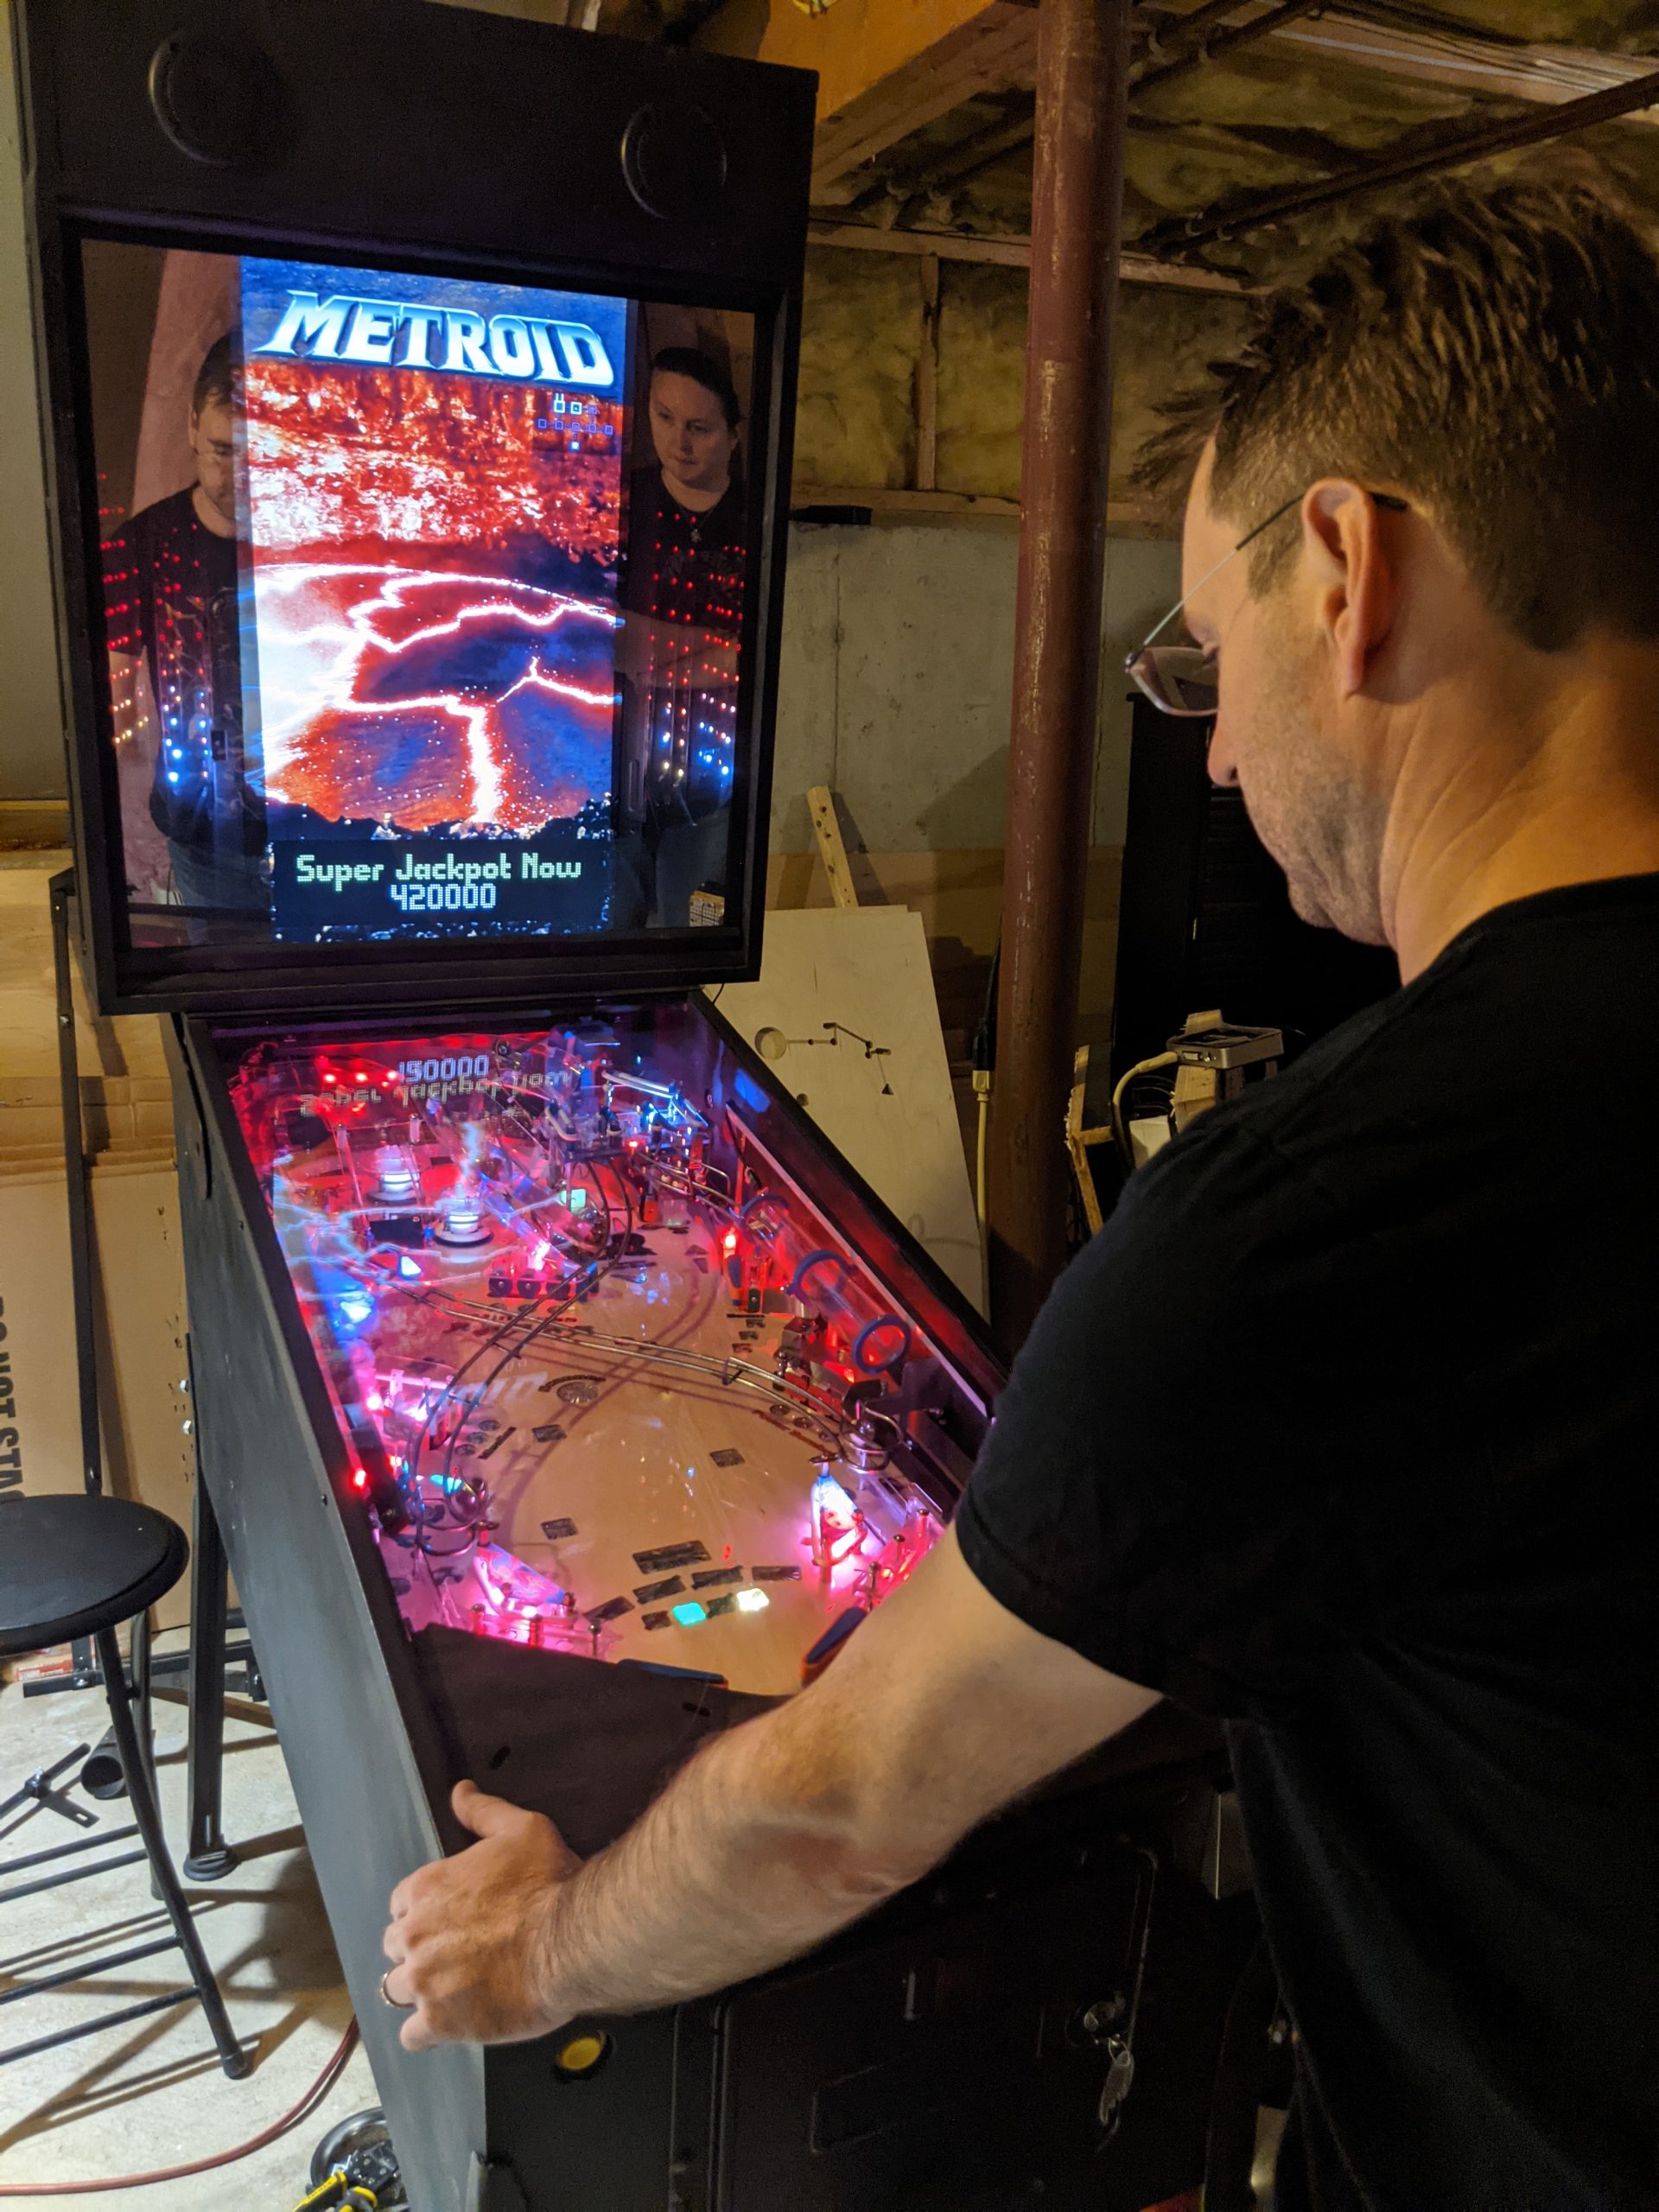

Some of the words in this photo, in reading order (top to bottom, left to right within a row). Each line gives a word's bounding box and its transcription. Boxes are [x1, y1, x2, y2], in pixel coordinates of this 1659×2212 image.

[251, 289, 614, 387] METROID
[296, 853, 385, 893] Super
[395, 852, 512, 886] Jackpot
[521, 851, 582, 880] Now
[390, 882, 497, 911] 420000
